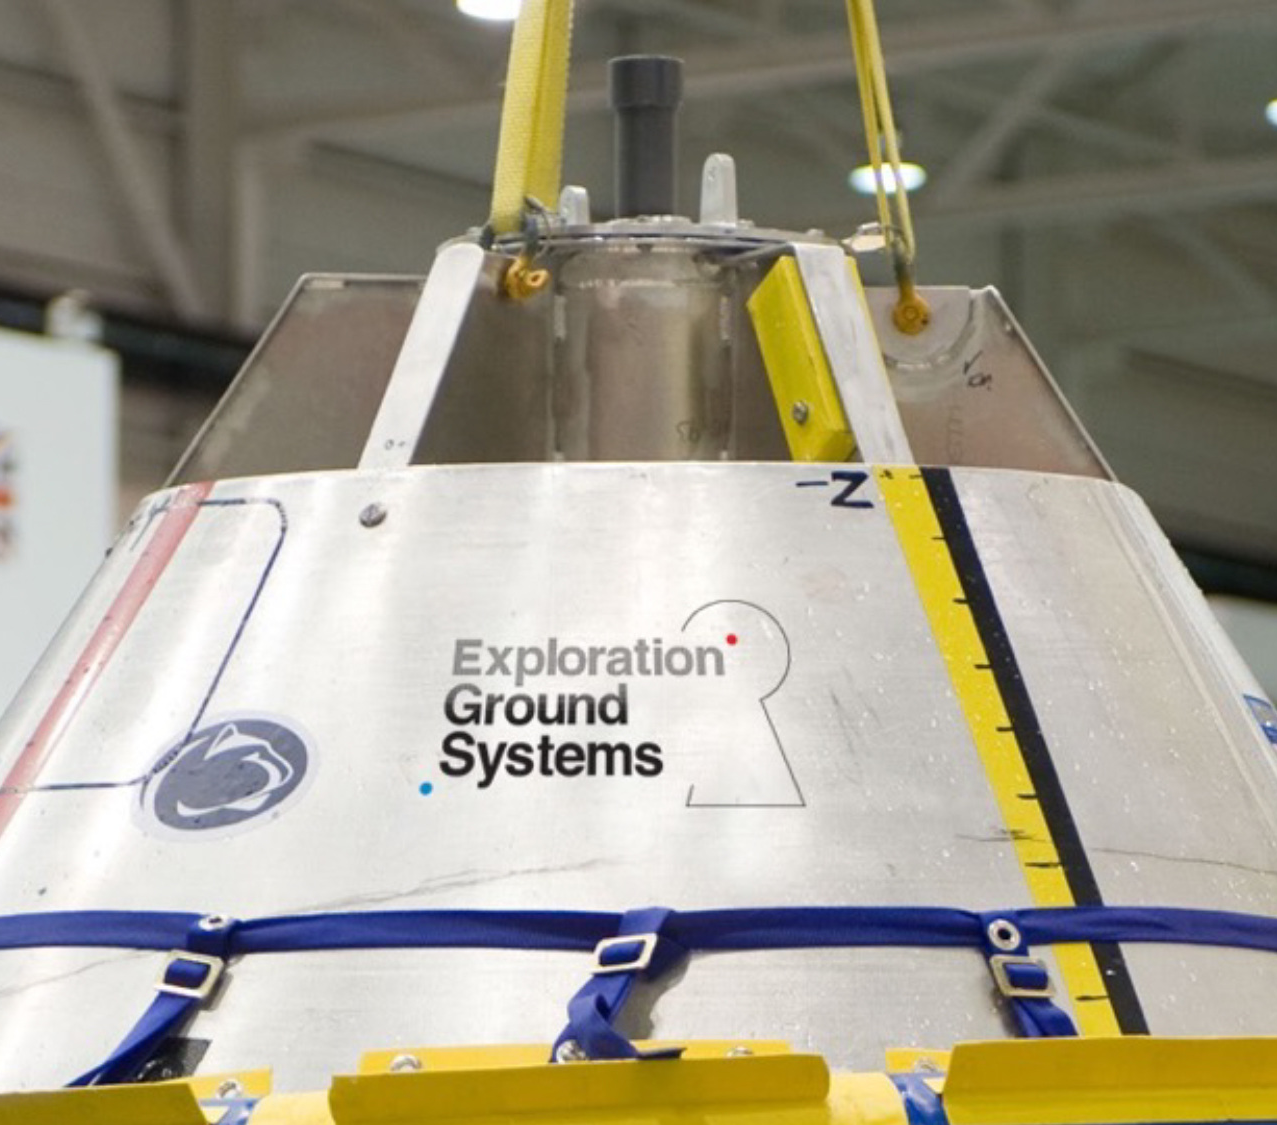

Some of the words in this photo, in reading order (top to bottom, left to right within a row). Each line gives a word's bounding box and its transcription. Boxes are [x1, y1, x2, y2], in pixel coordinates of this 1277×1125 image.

[451, 637, 725, 686] Exploration
[443, 684, 629, 727] Ground
[438, 732, 664, 788] Systems
